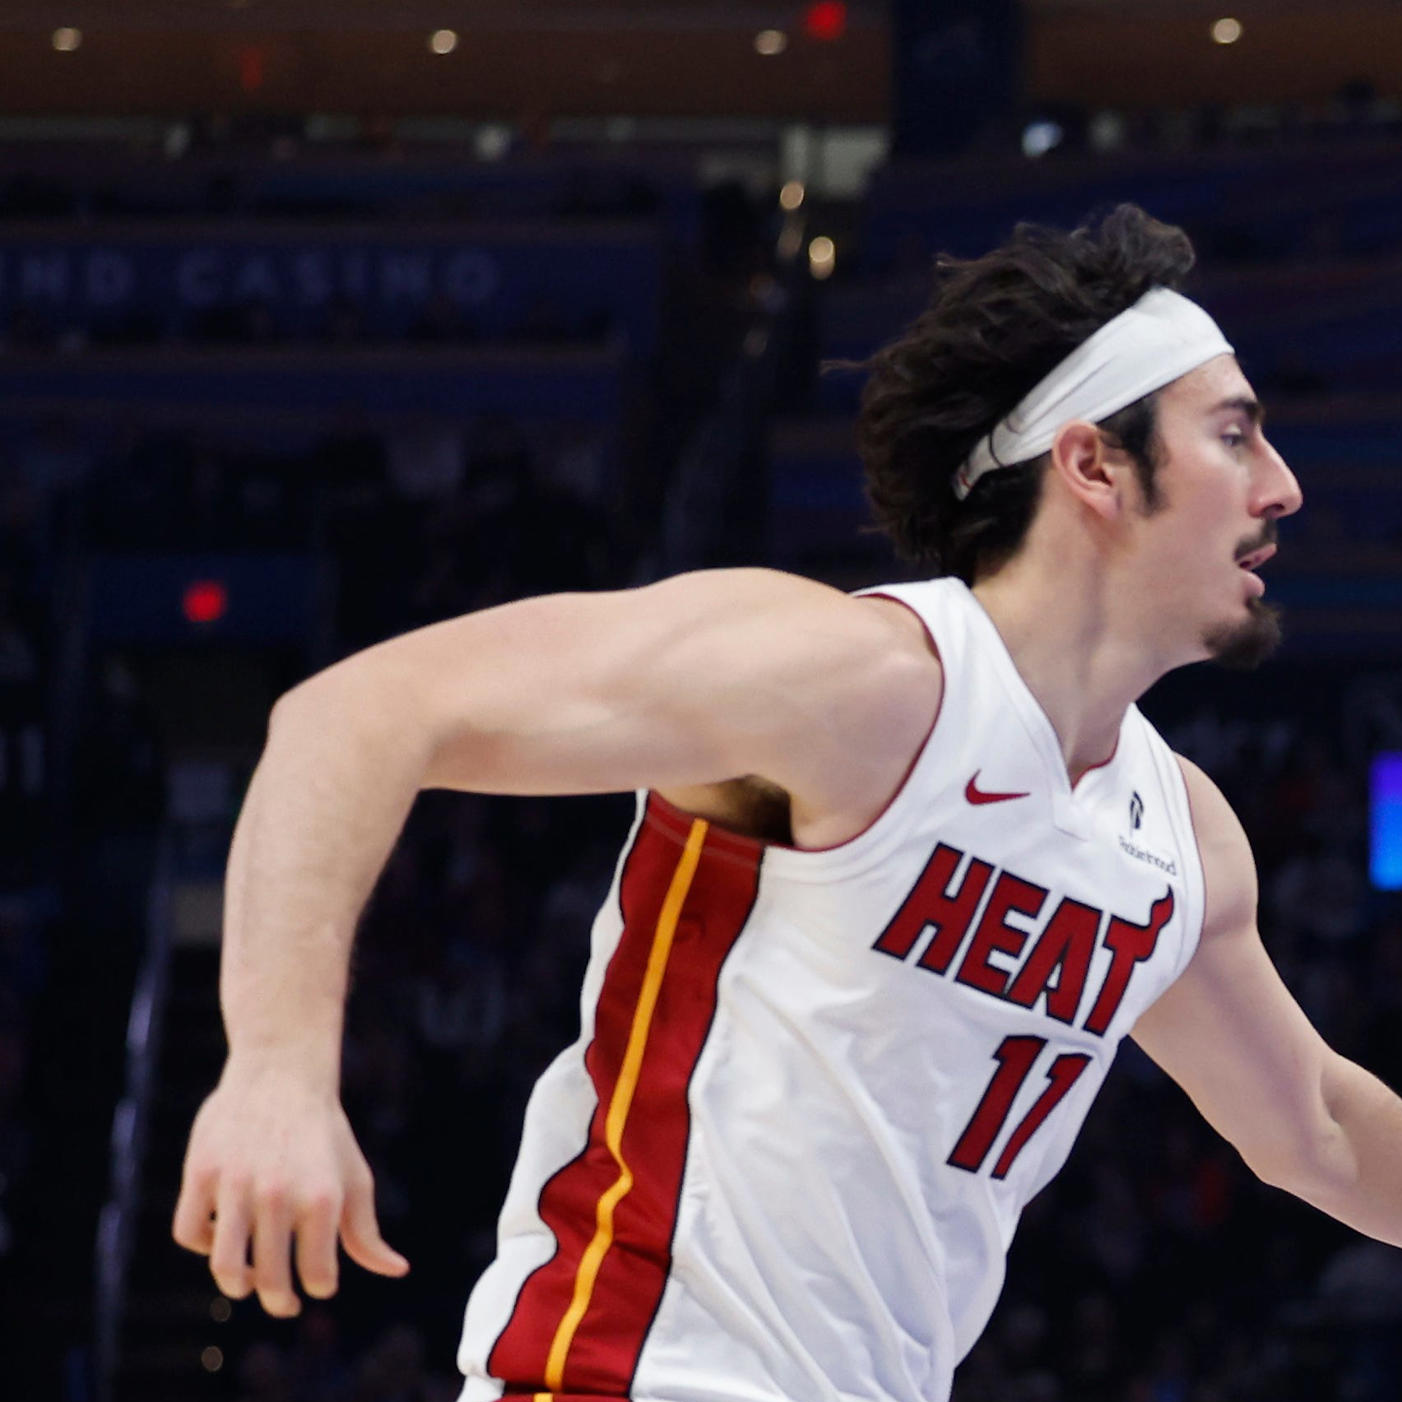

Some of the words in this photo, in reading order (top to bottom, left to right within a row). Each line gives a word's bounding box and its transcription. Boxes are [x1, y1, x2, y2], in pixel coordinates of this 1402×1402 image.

[177, 249, 500, 306] CASINO
[872, 841, 1175, 1037] HEAT
[946, 1033, 1093, 1181] 11
